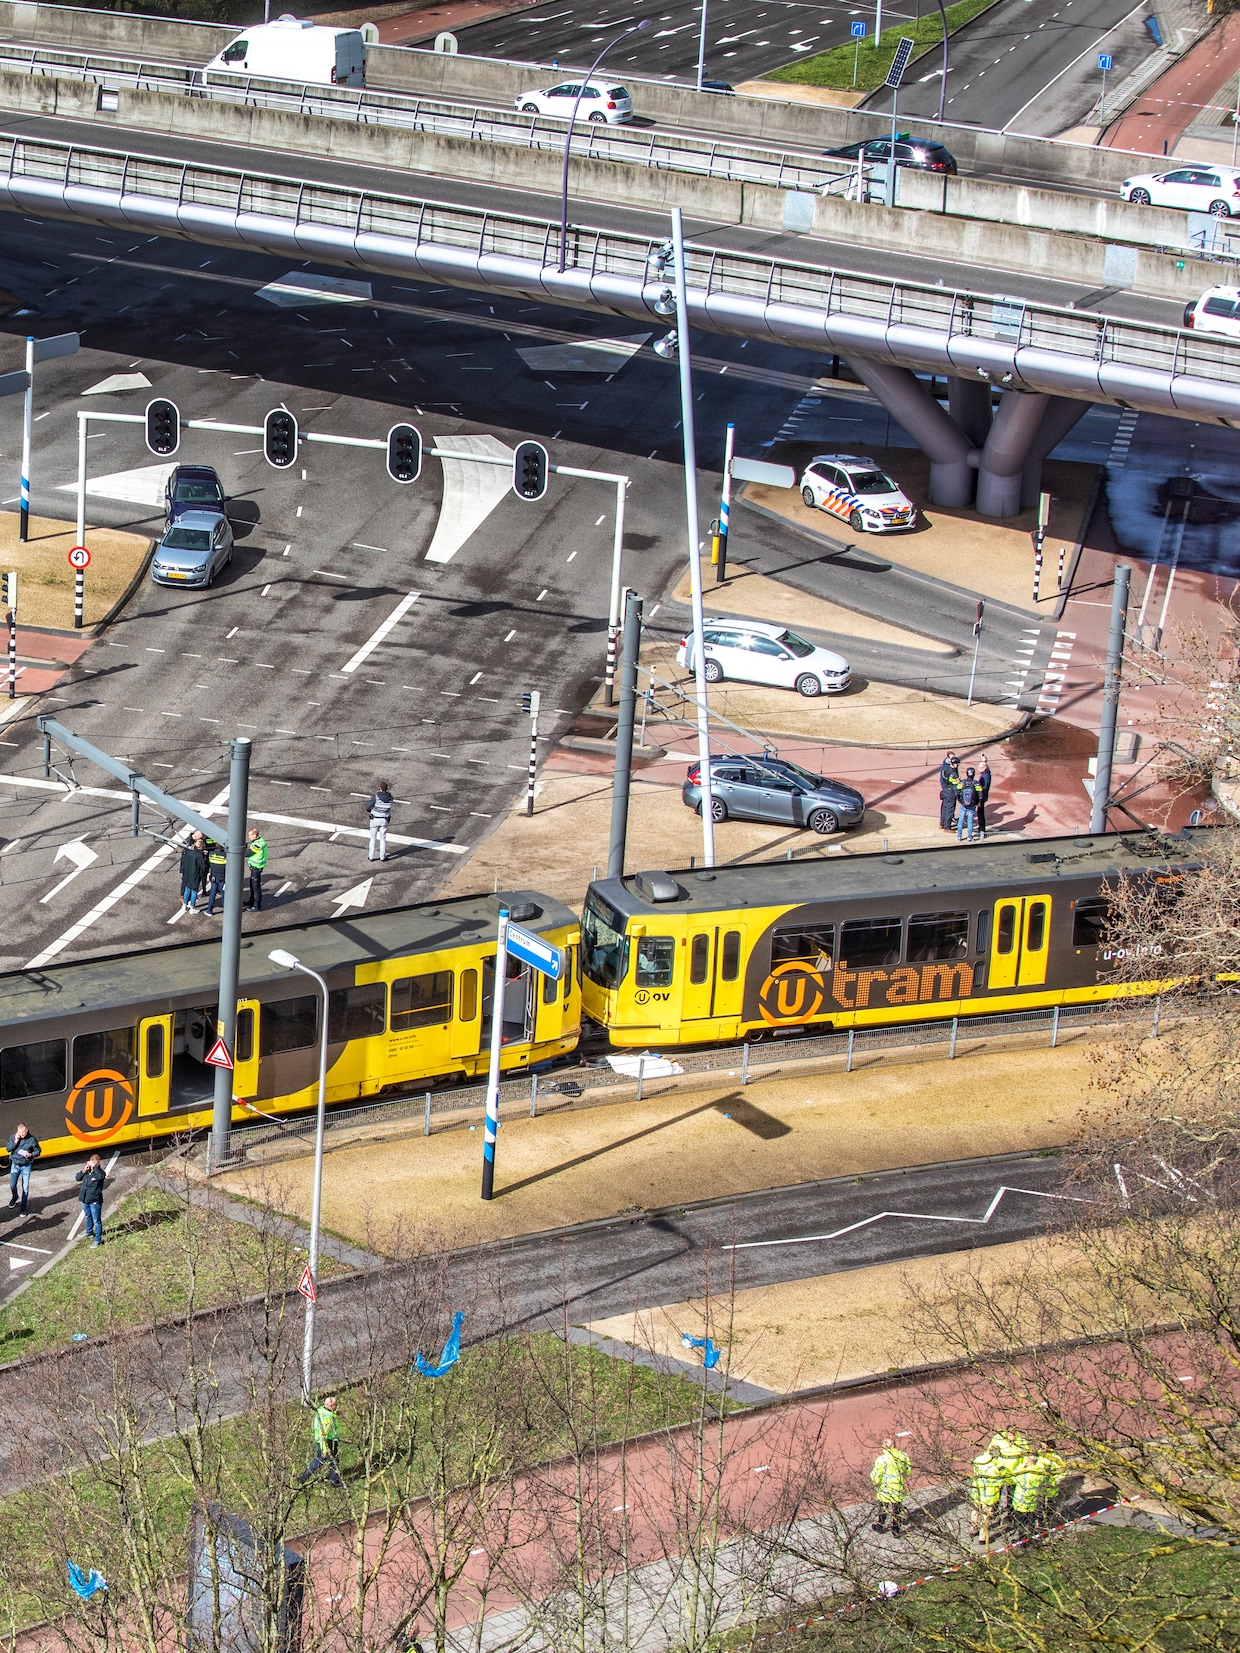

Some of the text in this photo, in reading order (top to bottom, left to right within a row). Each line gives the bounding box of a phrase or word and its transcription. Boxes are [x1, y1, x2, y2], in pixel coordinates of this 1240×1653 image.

[509, 929, 531, 948] Centrum
[832, 960, 974, 1008] tram
[653, 993, 670, 1001] OV
